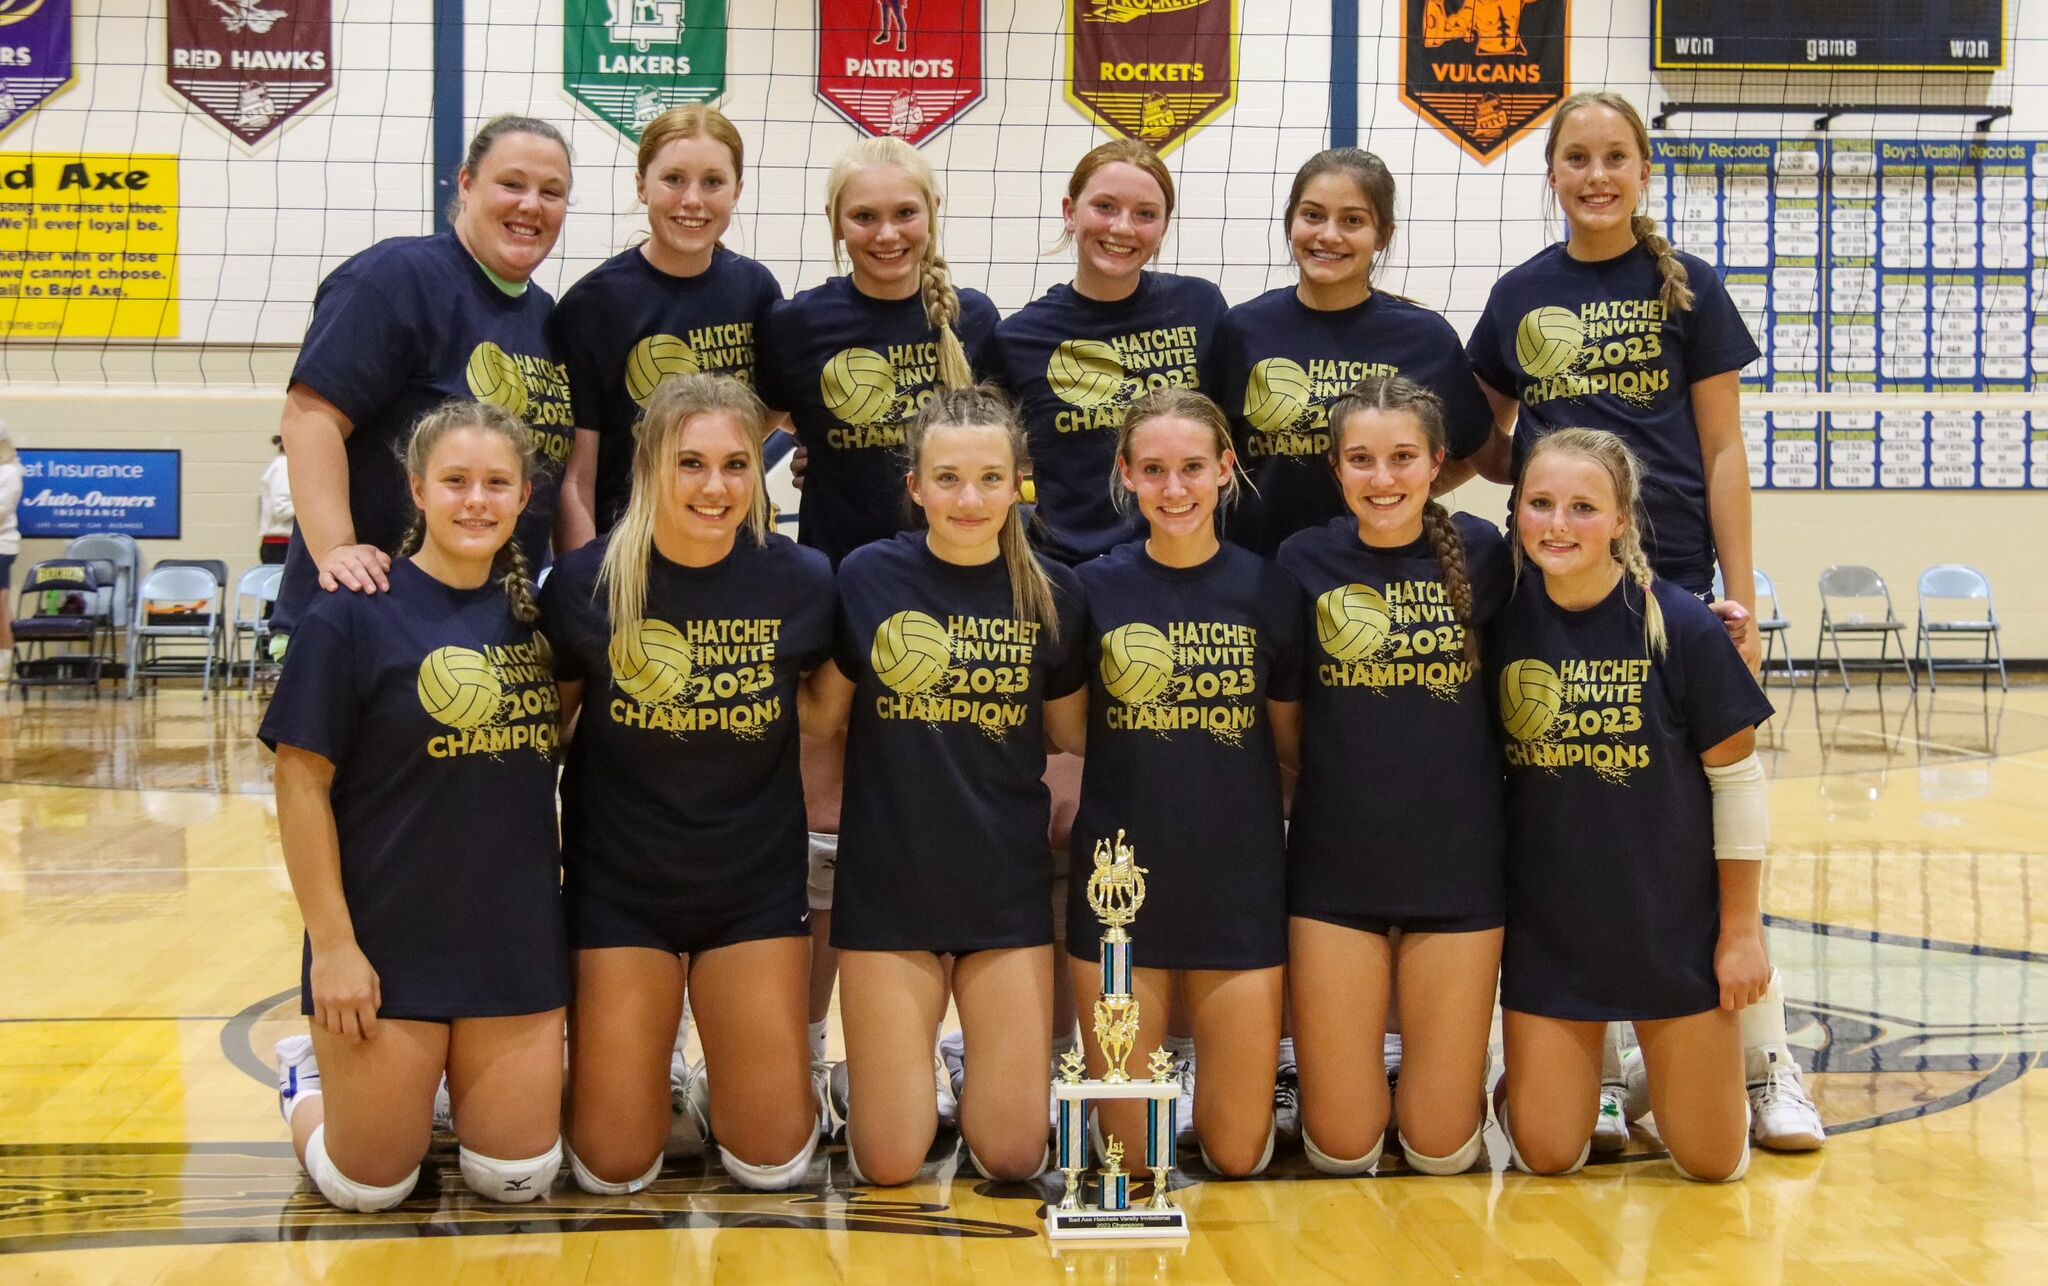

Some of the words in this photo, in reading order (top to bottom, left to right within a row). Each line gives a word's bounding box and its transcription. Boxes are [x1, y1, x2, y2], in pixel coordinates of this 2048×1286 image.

[1675, 37, 1714, 56] won
[1806, 38, 1857, 62] game
[1950, 39, 1989, 58] won
[174, 49, 221, 68] RED
[231, 50, 326, 70] HAWKS
[598, 54, 691, 75] LAKERS
[846, 58, 954, 78] PATRIOTS
[1100, 63, 1204, 82] ROCKETS
[1432, 63, 1541, 83] VULCANS
[1657, 143, 1704, 160] Varsity
[1709, 143, 1771, 158] Records
[1922, 145, 1965, 161] Varsity
[1970, 145, 2025, 159] Records
[57, 162, 150, 191] Axe
[110, 203, 124, 214] to
[44, 220, 82, 231] ever
[89, 218, 130, 233] loyal
[137, 219, 163, 231] be.
[30, 268, 91, 280] cannot
[25, 285, 42, 296] to
[48, 284, 82, 297] Bad
[1581, 300, 1668, 321] HATCHET
[689, 322, 754, 352] HATCHE
[1111, 326, 1197, 353] HATCHET
[1588, 320, 1662, 338] INVITE
[1123, 348, 1197, 370] INVITE
[1582, 334, 1662, 371] 2023
[513, 352, 570, 385] HATCHET
[526, 376, 571, 401] INVITE
[1123, 366, 1200, 400] 2023
[1524, 369, 1669, 407] CHAMPIONS
[48, 461, 144, 478] Insurance
[23, 489, 157, 508] Auto-Owners
[53, 508, 126, 517] INSURANCE
[1386, 580, 1450, 603] HATCH
[1395, 604, 1455, 624] INVIT
[687, 619, 781, 643] HATCHET
[948, 615, 1041, 645] HATCHET
[1168, 622, 1257, 647] HATCHET
[1388, 624, 1466, 658] 2023
[483, 643, 538, 666] HATCH
[696, 643, 775, 666] INVITE
[955, 640, 1033, 664] INVITE
[1178, 647, 1255, 666] INVITE
[948, 666, 1030, 694] 2023
[1318, 661, 1473, 687] CHAMPIONS
[1560, 659, 1652, 682] HATCHET
[691, 662, 775, 703] 2023
[1173, 668, 1256, 701] 2023
[1564, 683, 1642, 703] INVITE
[610, 696, 782, 731] CHAMPIONS
[876, 695, 1028, 727] CHAMPIONS
[1106, 706, 1256, 730] CHAMPIONS
[1559, 705, 1643, 739] 2023
[427, 723, 561, 759] CHAMPION
[1504, 744, 1651, 769] CHAMPIONS
[1107, 1133, 1124, 1150] 1st
